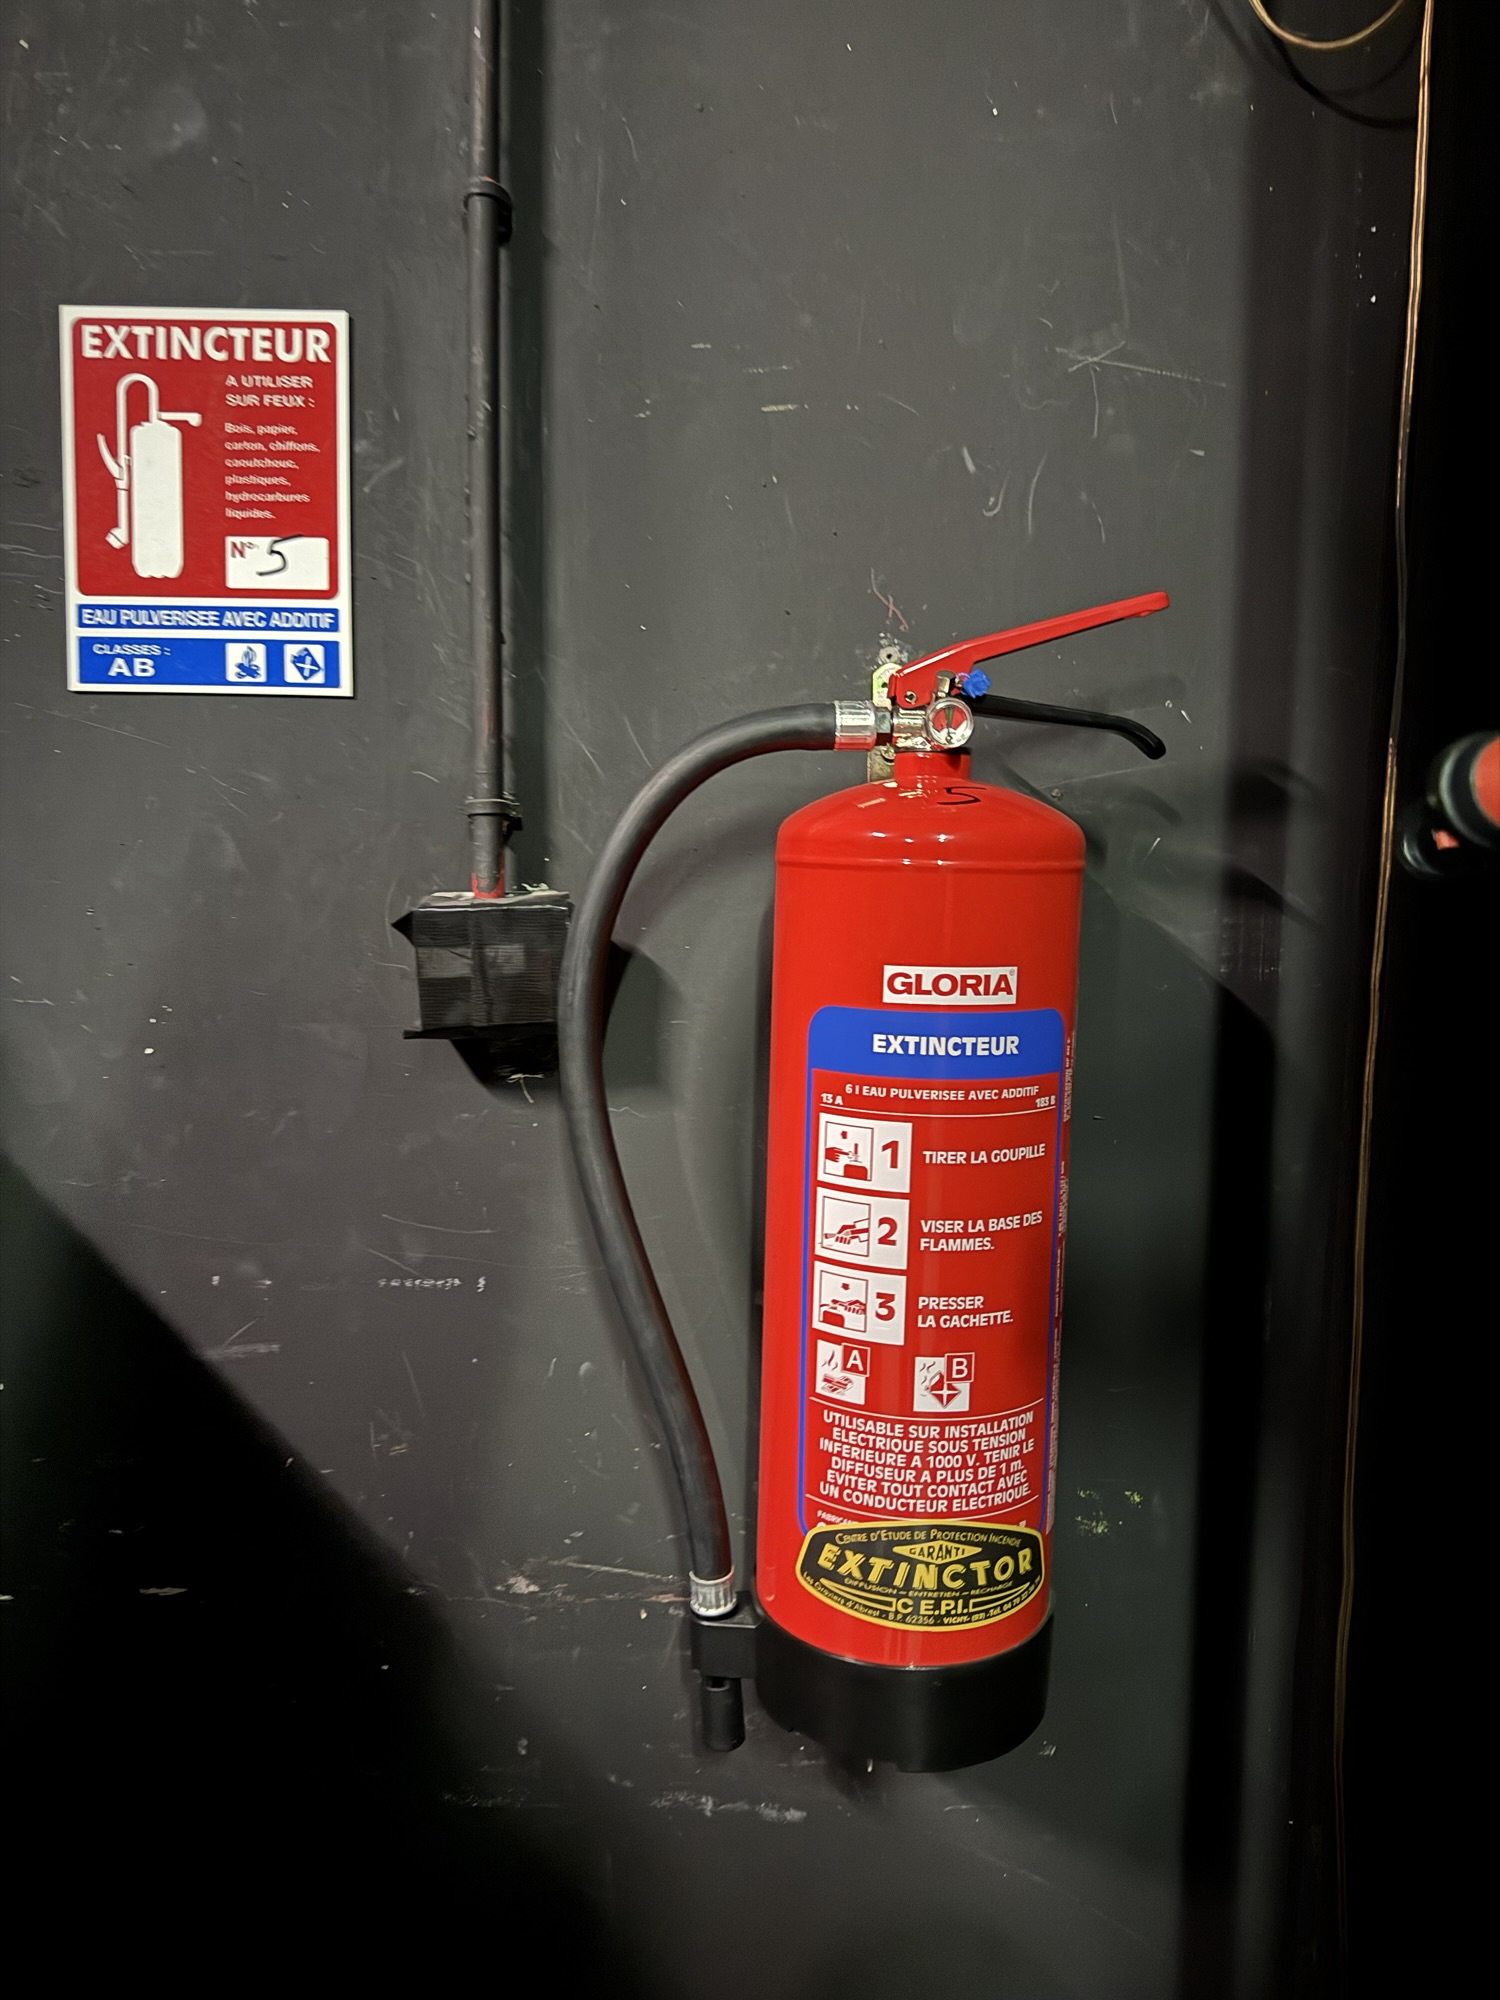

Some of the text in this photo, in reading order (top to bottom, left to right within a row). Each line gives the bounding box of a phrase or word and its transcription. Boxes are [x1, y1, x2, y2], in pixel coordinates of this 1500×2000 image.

[81, 324, 332, 363] EXTINCTEUR
[225, 374, 314, 389] A UTILISER
[225, 393, 260, 407] SUR
[262, 394, 306, 408] FEUX
[224, 440, 321, 453] carton, chiffons,
[224, 457, 300, 470] caoutchouc,
[224, 474, 292, 487] plastiques,
[256, 533, 304, 577] 5
[81, 608, 336, 629] EAU PULVERISEE AVEC ADDITIF
[92, 643, 162, 656] CLASSES
[107, 657, 156, 677] AB
[886, 971, 1014, 997] GLORIA
[872, 1033, 1020, 1057] EXTINCTEUR
[820, 1092, 844, 1106] 13 A
[845, 1083, 853, 1094] 6
[862, 1085, 887, 1098] EAU
[890, 1087, 966, 1101] PULVERISEE
[968, 1089, 999, 1101] AVEC
[1001, 1085, 1040, 1099] ADDITIF
[881, 1140, 899, 1169] 1
[922, 1143, 1046, 1165] TIRER LA GOUPILLE
[877, 1216, 898, 1247] 2
[920, 1210, 1043, 1234] VISER LA BASE DES
[919, 1237, 995, 1252] FLAMMES.
[875, 1291, 896, 1321] 3
[918, 1295, 985, 1310] PRESSER
[917, 1310, 1014, 1328] LA GACHETTE.
[846, 1349, 864, 1372] A
[951, 1357, 969, 1379] B
[823, 1409, 1034, 1439] UTILISABLE SUR INSTALLATION
[832, 1426, 1027, 1454] ELECTRIQUE SOUS TENSION
[819, 1437, 1035, 1469] INFERIEURE A 1000 V. TENIR LE
[831, 1456, 1025, 1483] DIFFUSEUR A PLUS DE 1 m.
[826, 1469, 1028, 1499] EVITER TOUT CONTACT AVEC
[819, 1480, 1032, 1513] UN CONDUCTEUR ELECTRIQUE.
[913, 1530, 927, 1540] DE
[930, 1528, 988, 1543] PROTECTION
[909, 1543, 966, 1562] GARANTI
[817, 1542, 1034, 1590] EXTINCTOR
[844, 1577, 897, 1595] DIFFUSION
[908, 1589, 960, 1598] ENTRETIEN
